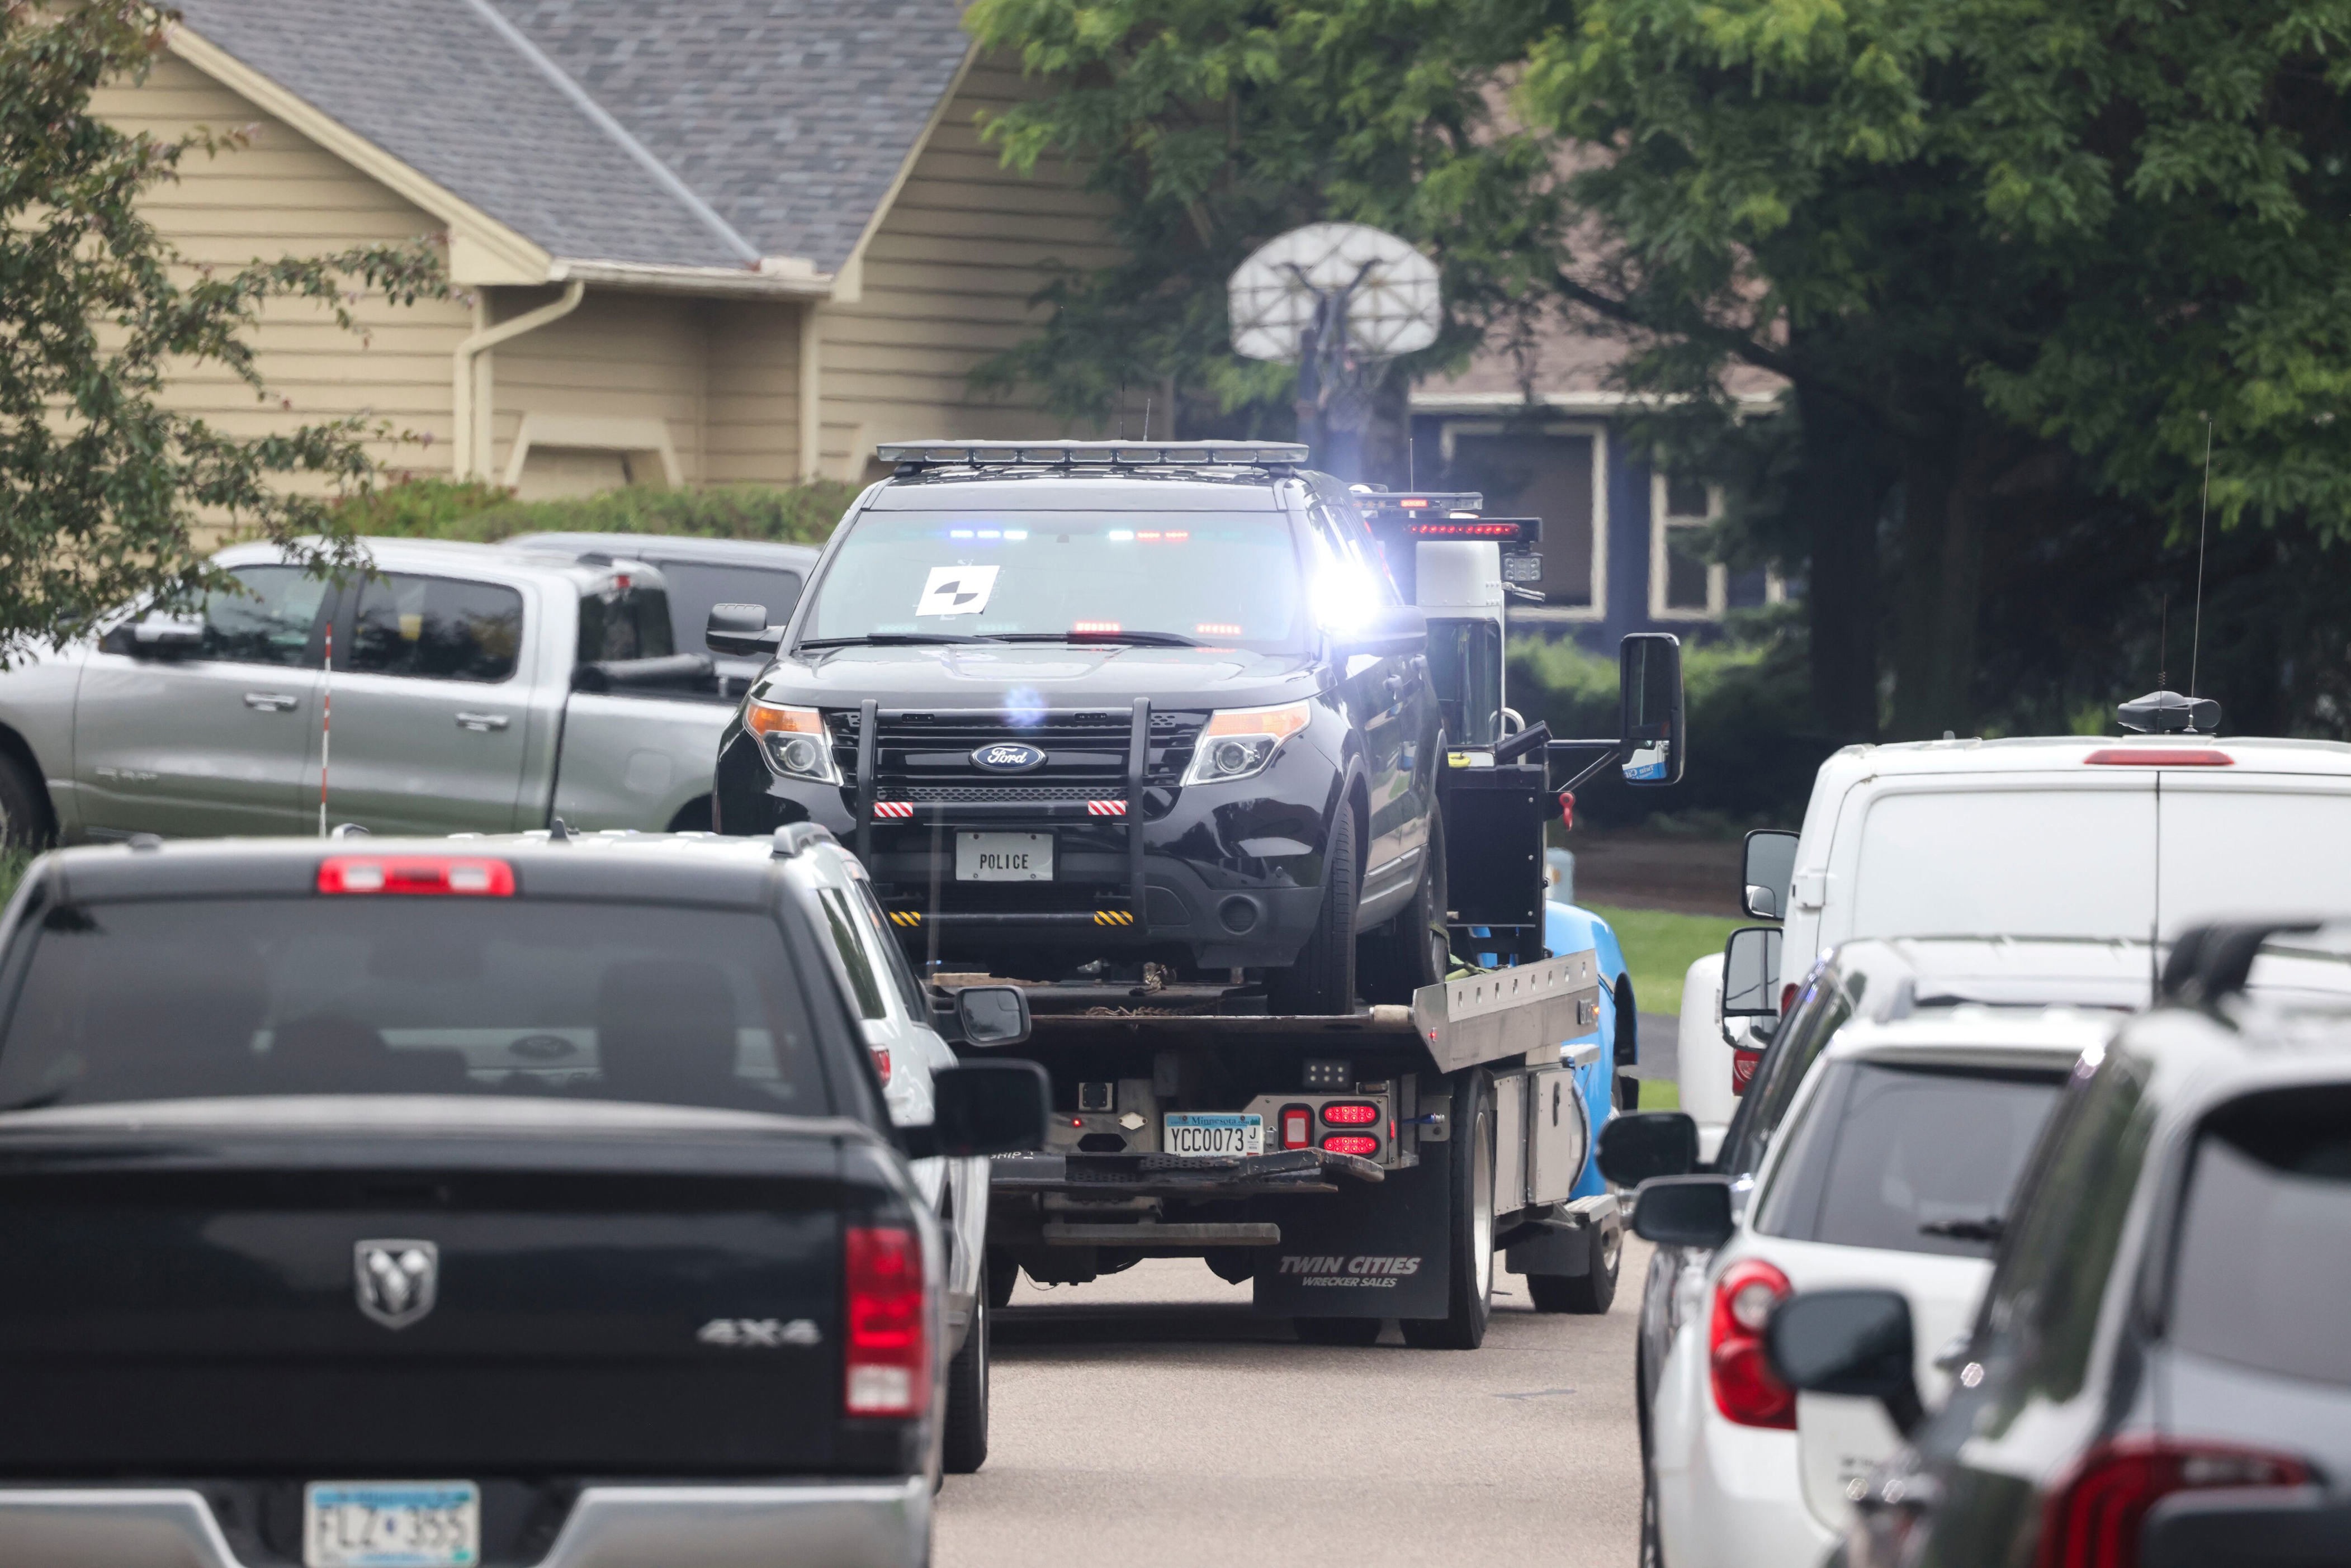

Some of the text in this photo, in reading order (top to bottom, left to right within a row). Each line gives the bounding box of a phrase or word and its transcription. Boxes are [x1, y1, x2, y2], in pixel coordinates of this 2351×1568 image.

[987, 747, 1028, 764] Ford
[980, 854, 1029, 869] POLICE
[1171, 1128, 1244, 1152] YCC0073
[1250, 1127, 1256, 1139] J
[1279, 1256, 1422, 1275] TWIN CITIES
[1302, 1277, 1397, 1287] WRECKER SALES
